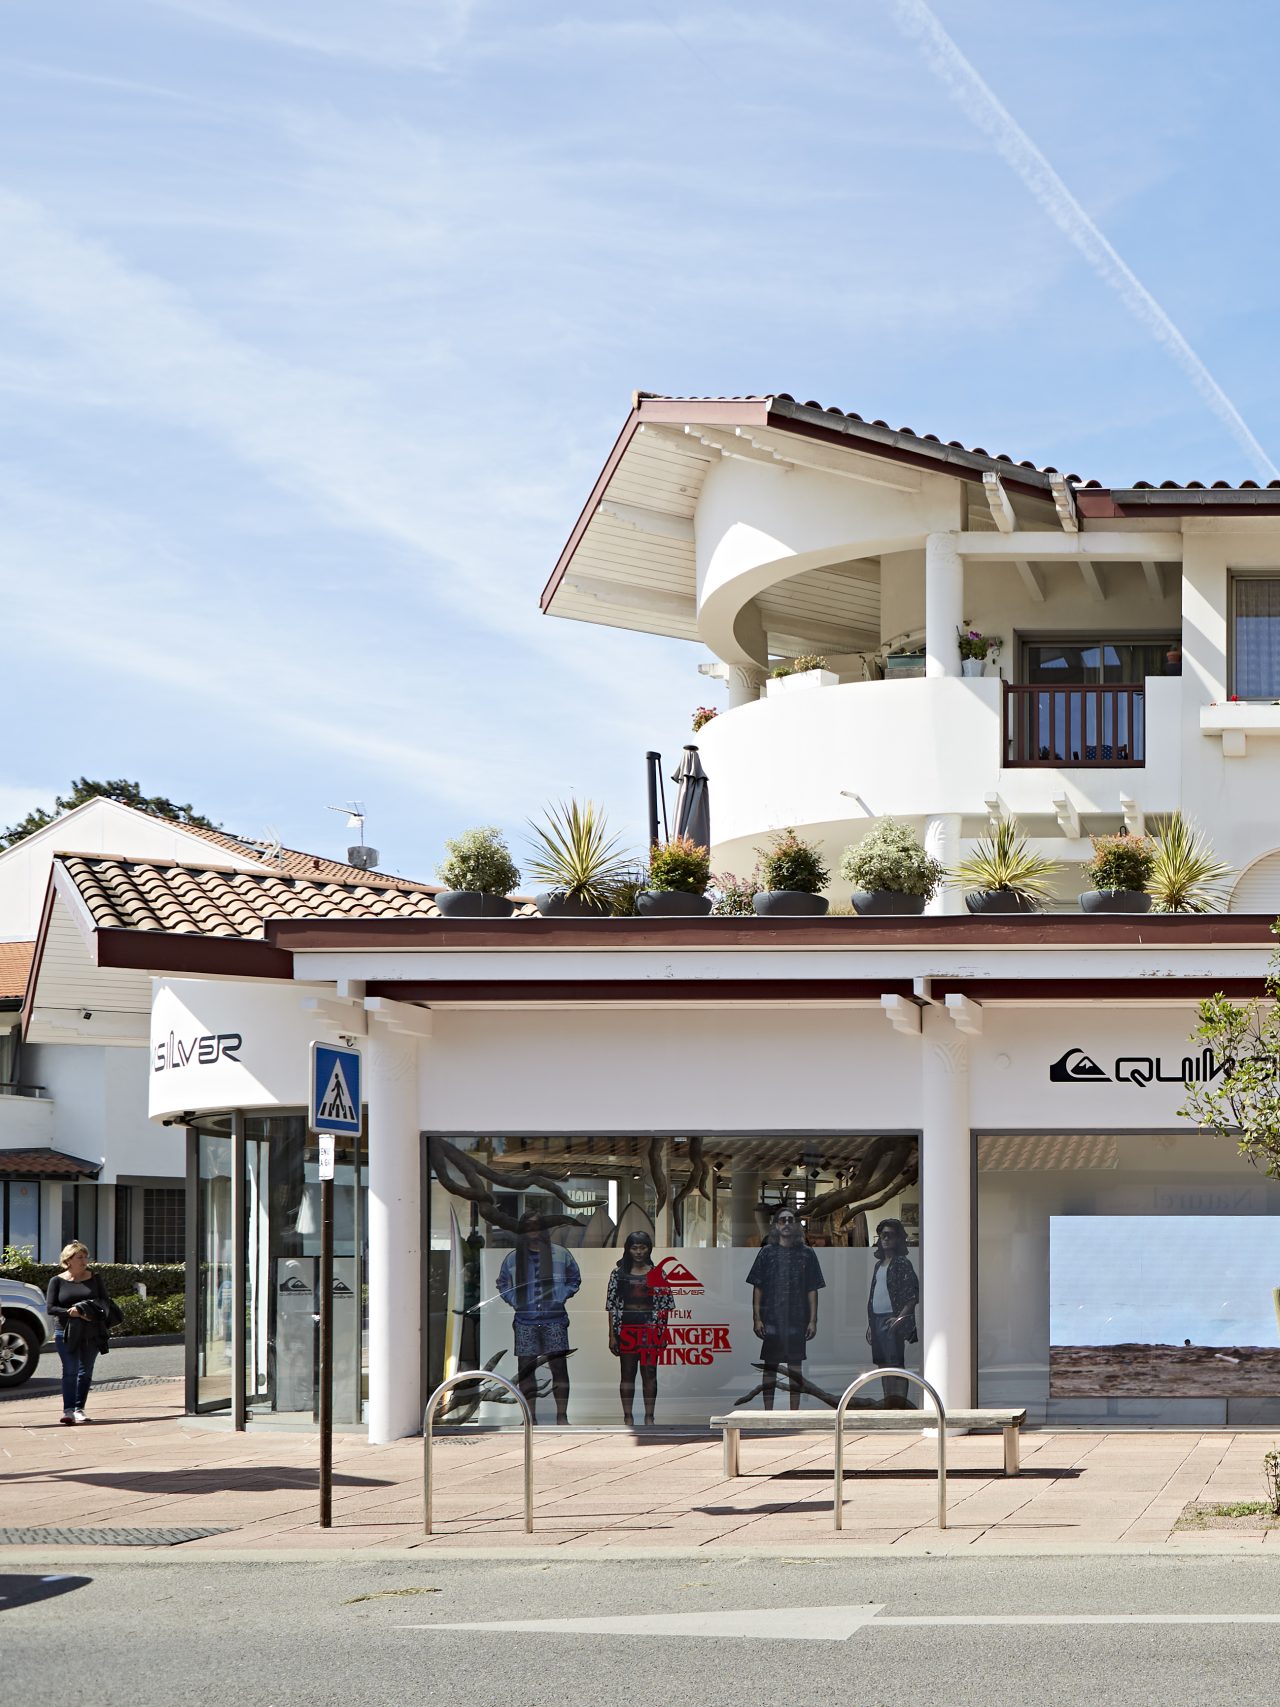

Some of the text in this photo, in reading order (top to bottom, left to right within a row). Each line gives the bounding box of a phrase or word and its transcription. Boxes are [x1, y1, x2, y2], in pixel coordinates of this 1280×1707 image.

[154, 1030, 242, 1072] SILVER
[620, 1327, 731, 1350] STRANGER
[638, 1348, 714, 1366] THINGS
